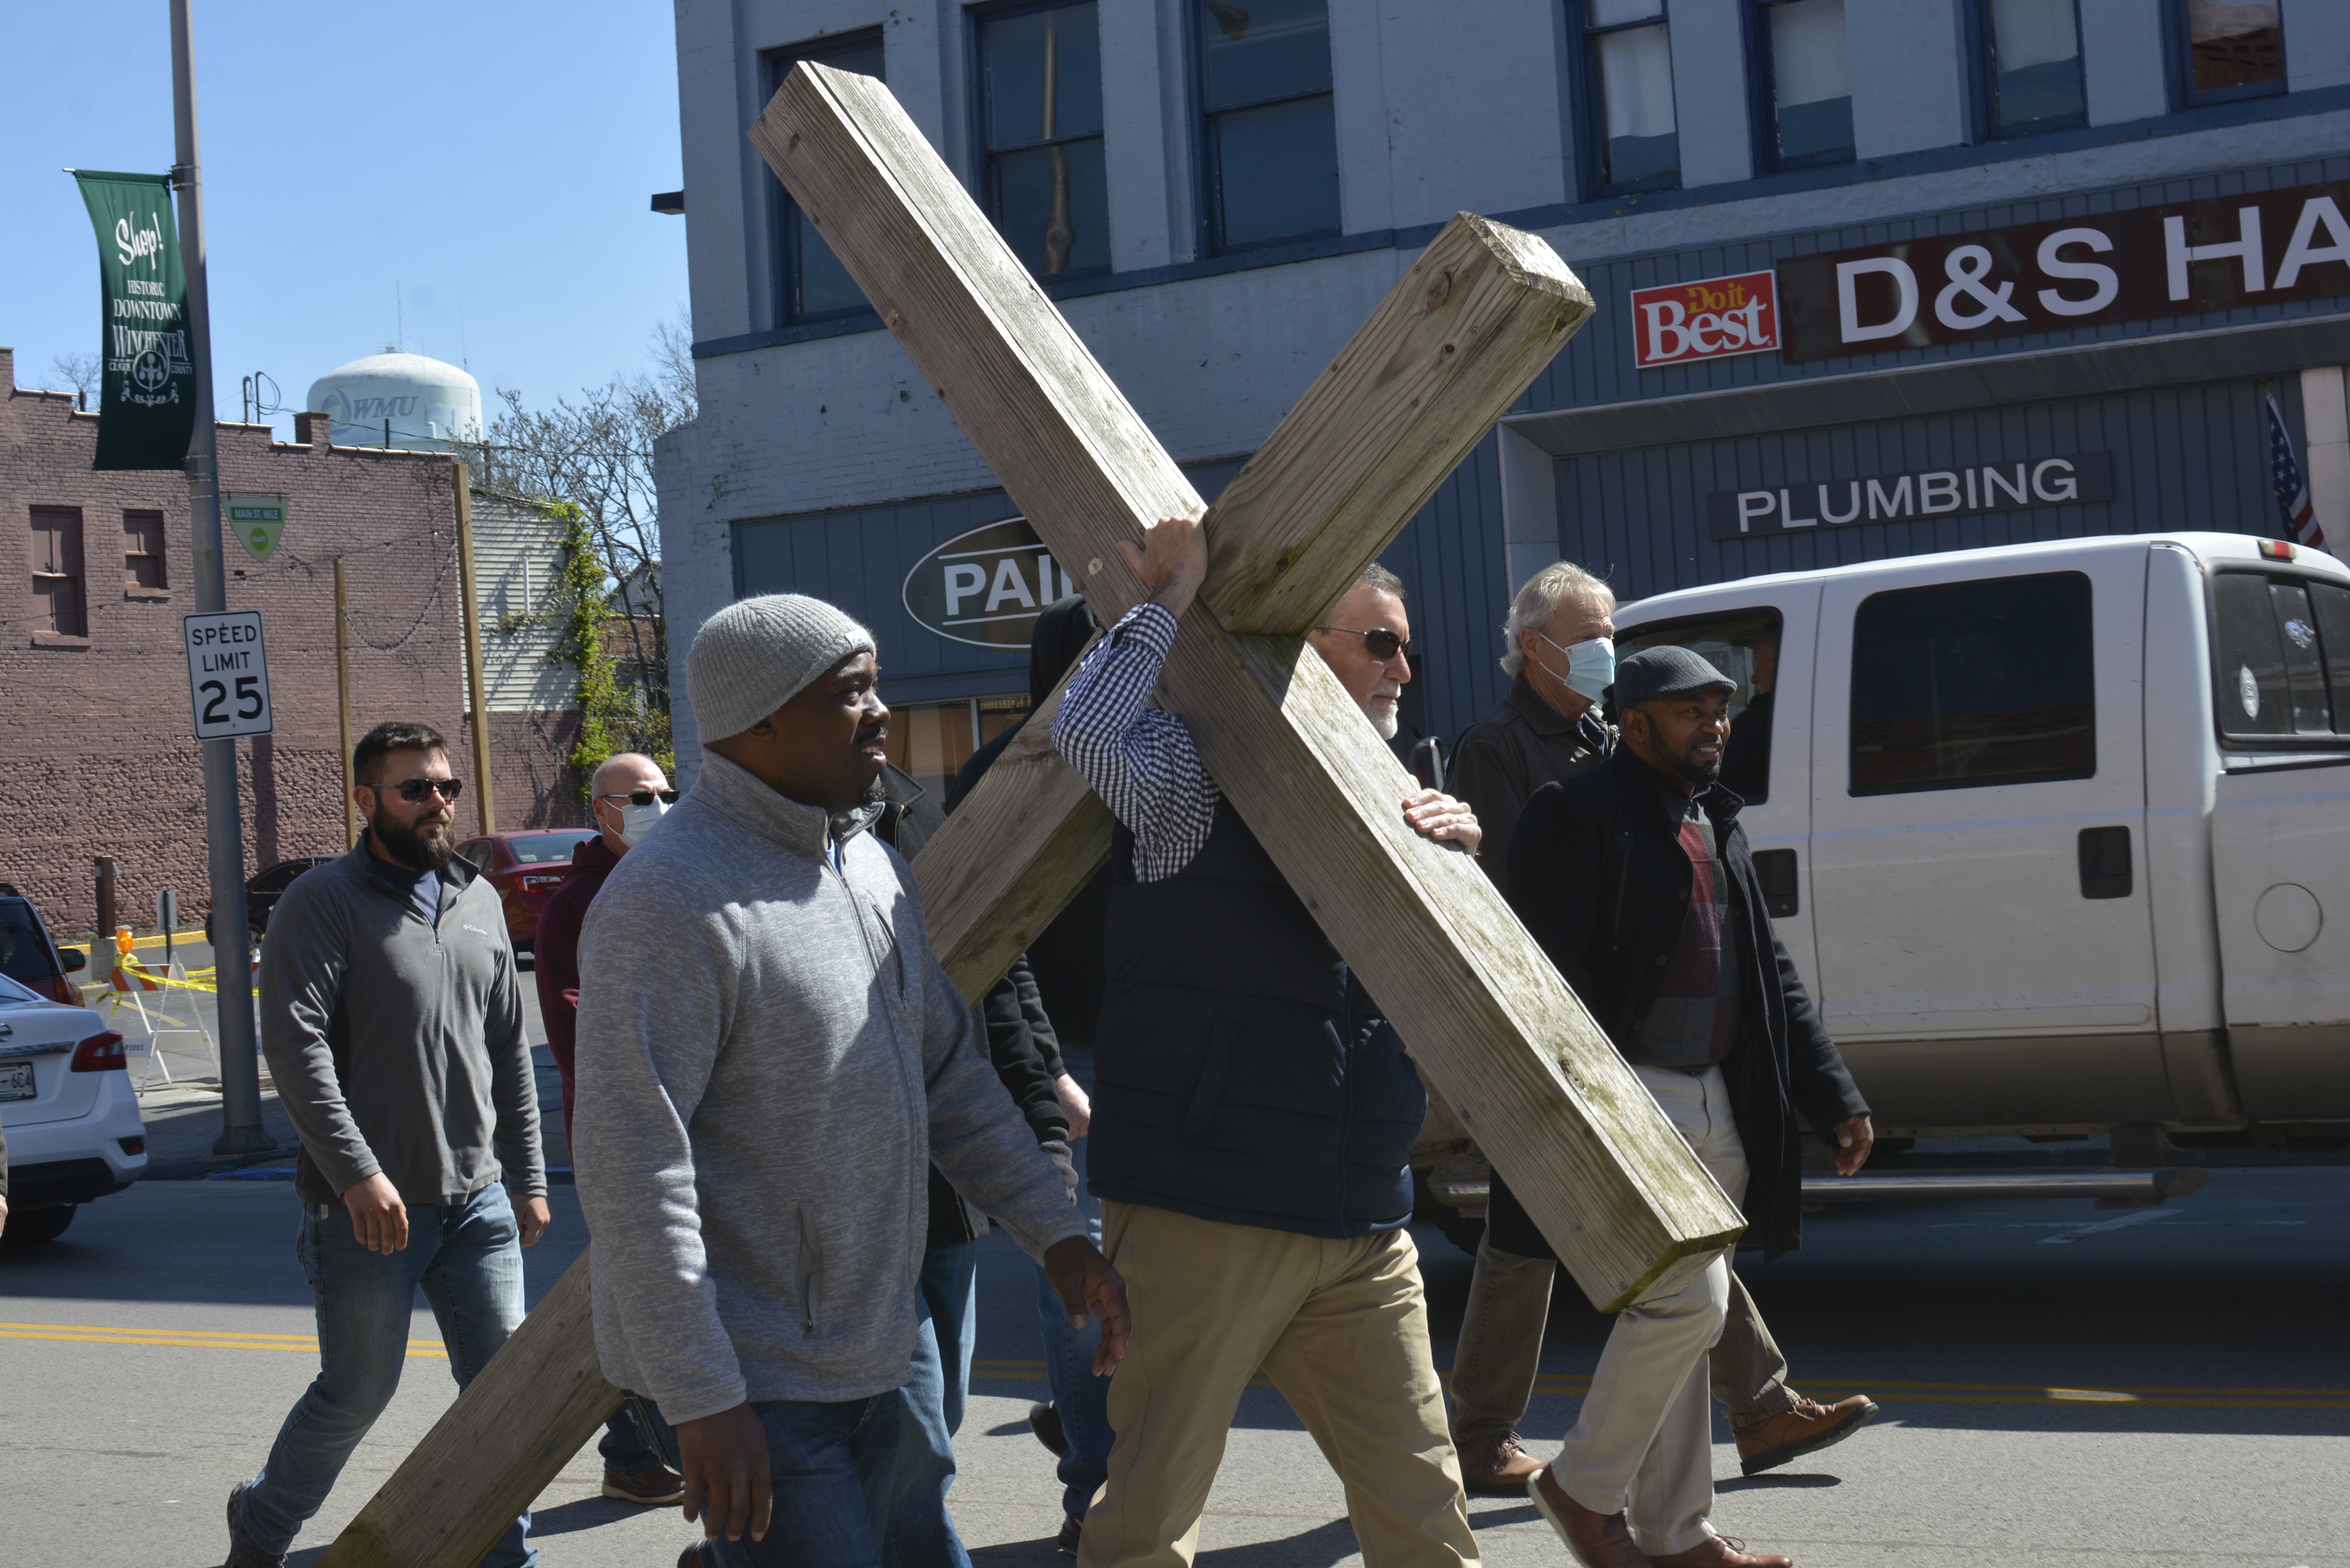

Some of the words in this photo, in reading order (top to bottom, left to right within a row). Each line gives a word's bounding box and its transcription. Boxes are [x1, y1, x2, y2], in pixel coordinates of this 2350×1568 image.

[115, 211, 164, 270] Shop!
[128, 280, 165, 297] HISTORIC
[1837, 227, 2119, 343] D&S
[114, 298, 181, 321] DOWNTOWN
[1685, 286, 1725, 314] Do
[1727, 282, 1747, 308] it
[1640, 295, 1770, 361] Best
[109, 362, 132, 374] CLARK
[170, 365, 192, 375] COUNTY
[353, 396, 418, 419] WMU
[1737, 459, 2078, 533] PLUMBING
[235, 509, 252, 518] MAIN
[263, 510, 279, 519] MILE
[192, 625, 257, 646] SPEED
[203, 651, 250, 672] LIMIT
[199, 676, 263, 725] 25
